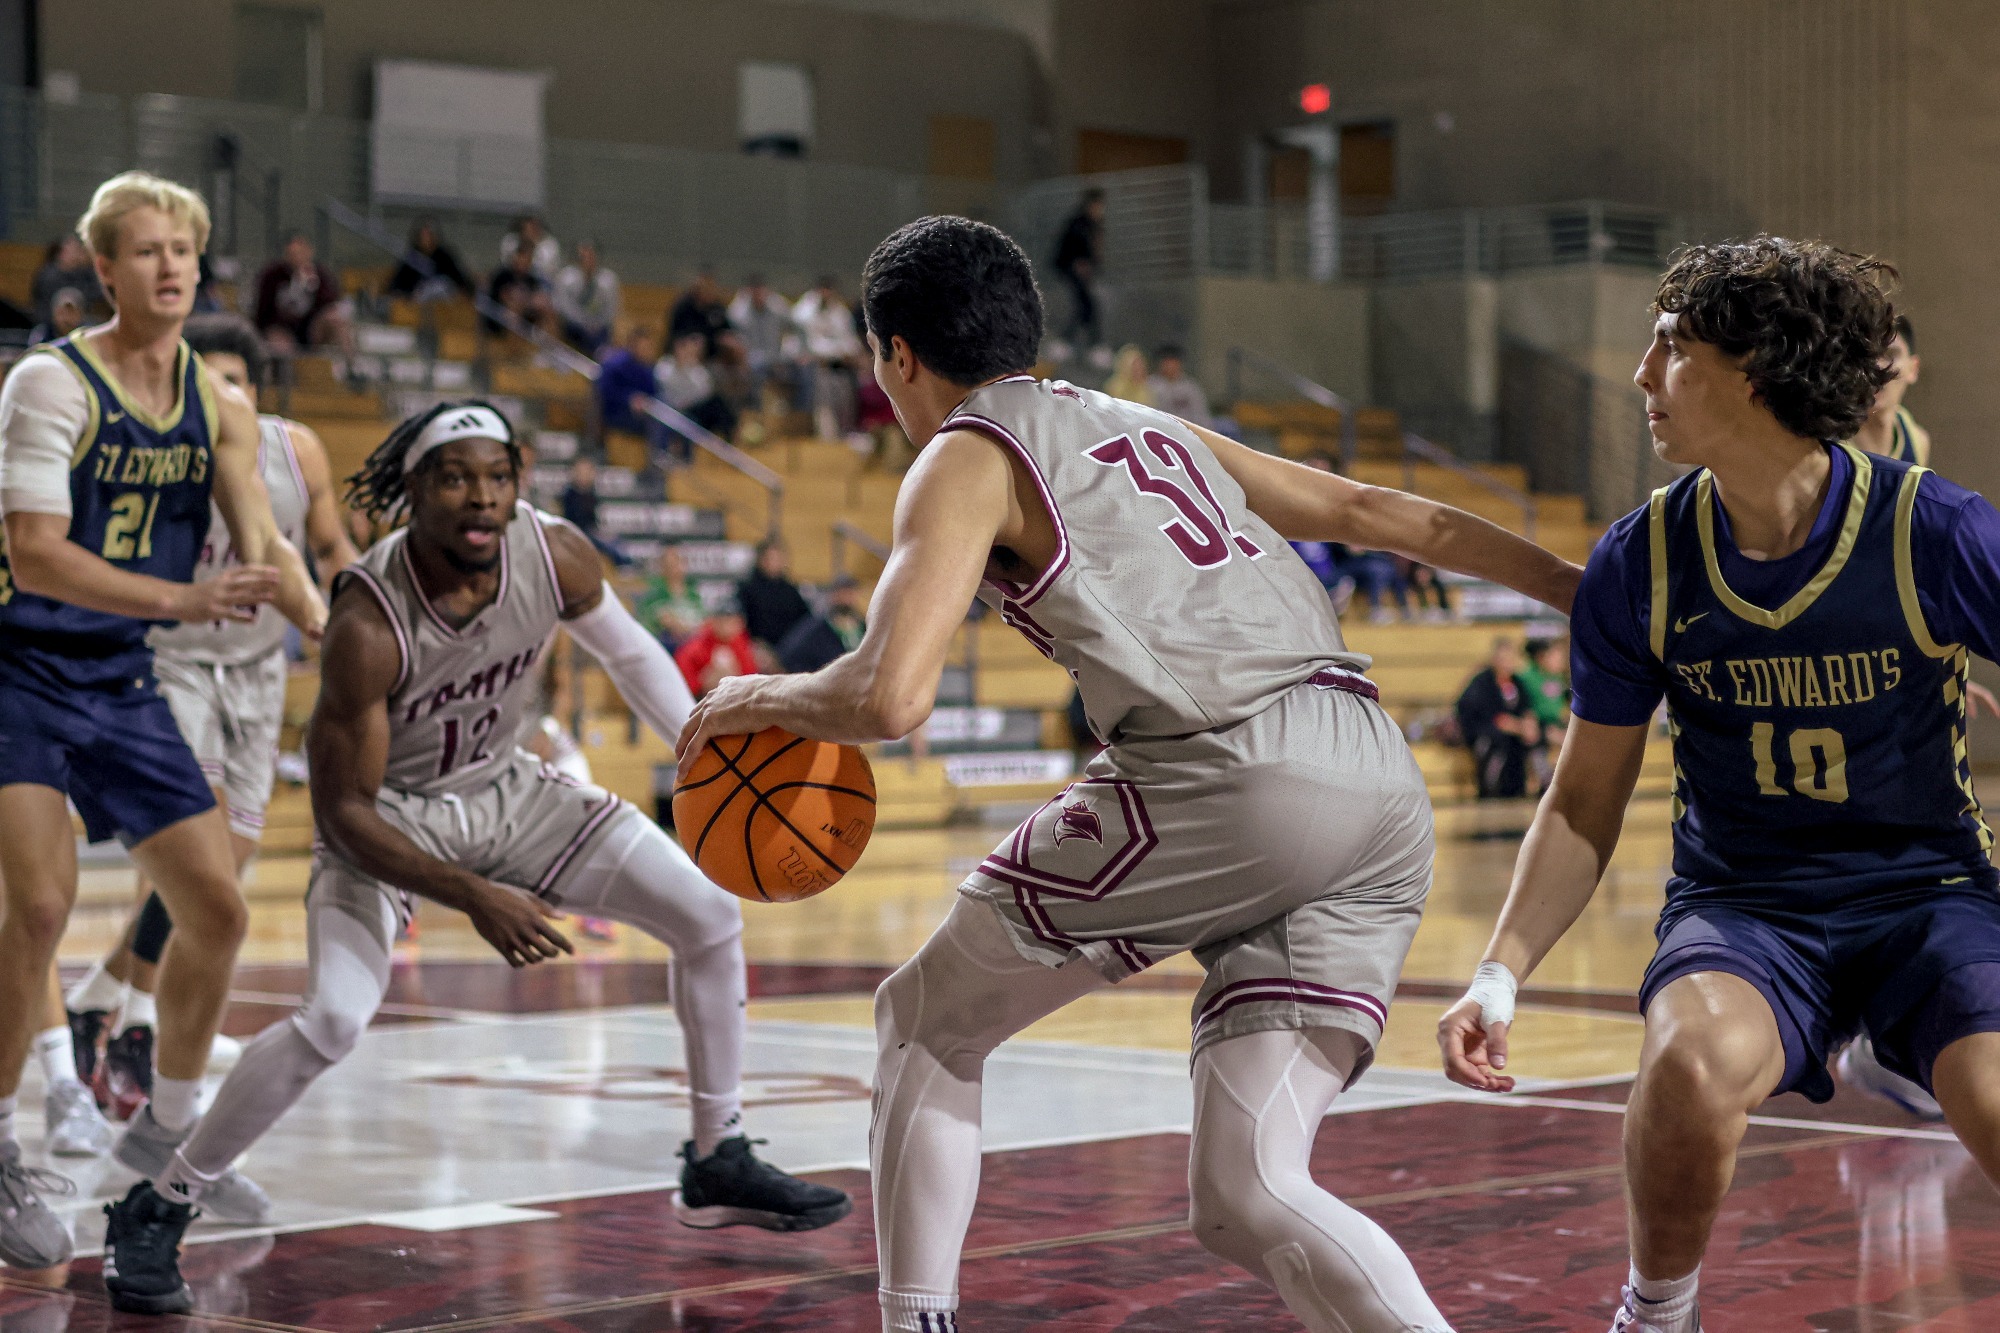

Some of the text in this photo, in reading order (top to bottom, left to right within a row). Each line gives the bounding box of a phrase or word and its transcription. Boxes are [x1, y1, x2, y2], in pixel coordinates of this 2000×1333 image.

[102, 492, 160, 560] 21
[1081, 427, 1267, 570] 32
[1726, 647, 1901, 707] EDWARD'S
[435, 703, 503, 778] 12
[1749, 722, 1849, 804] 10
